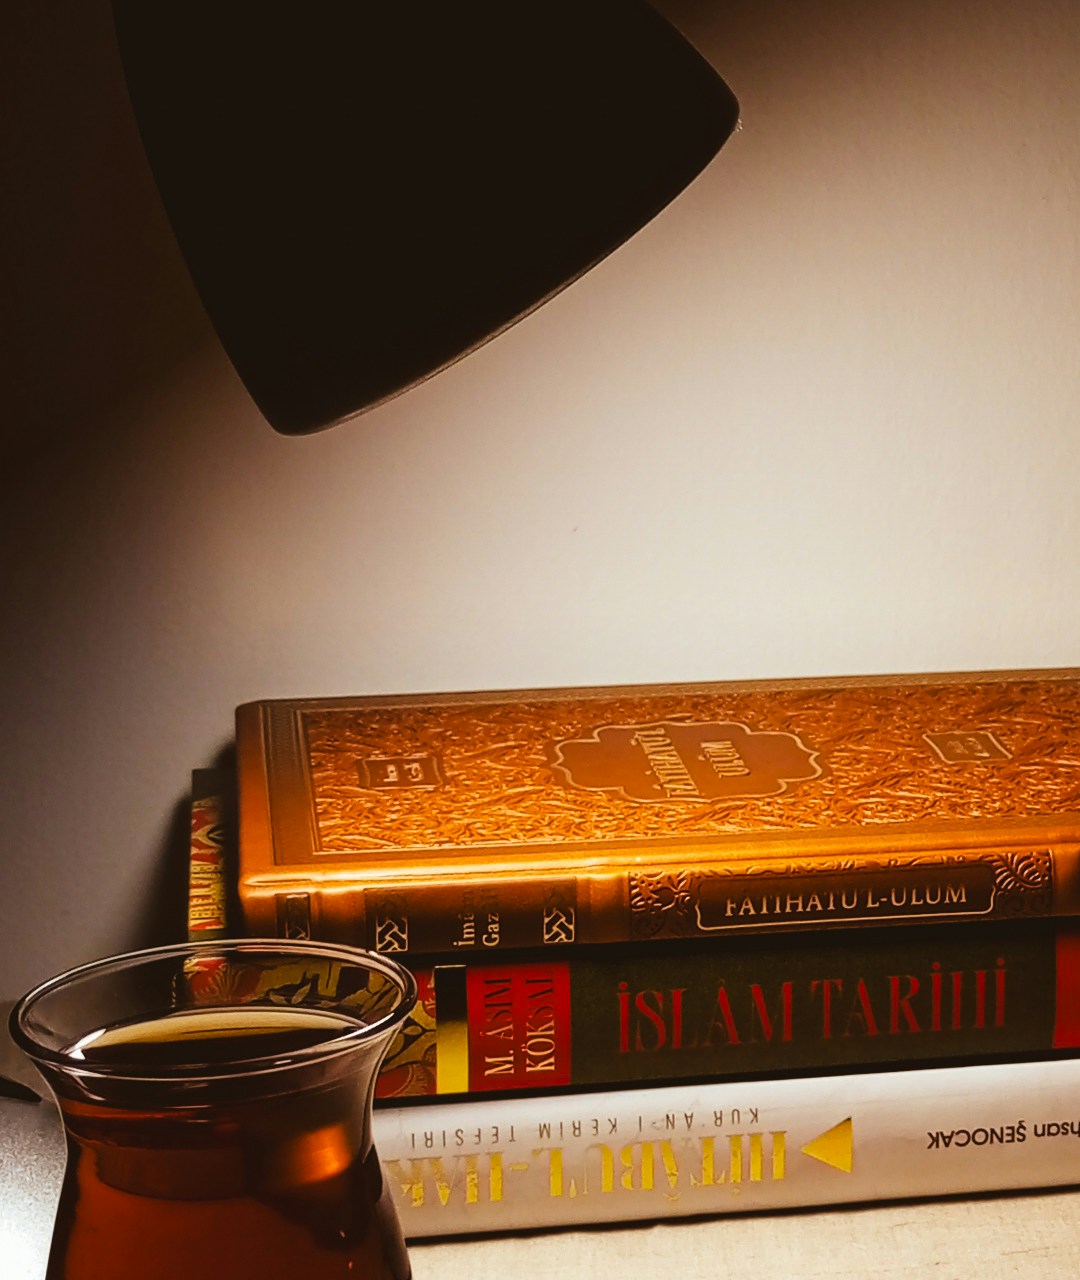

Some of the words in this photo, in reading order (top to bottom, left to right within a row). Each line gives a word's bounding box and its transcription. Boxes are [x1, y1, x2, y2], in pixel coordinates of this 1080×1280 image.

[616, 977, 794, 1055] İSLÂM
[810, 958, 1007, 1040] TARİHİ
[483, 1049, 515, 1076] M.
[926, 1117, 1028, 1150] ŞENOCAK
